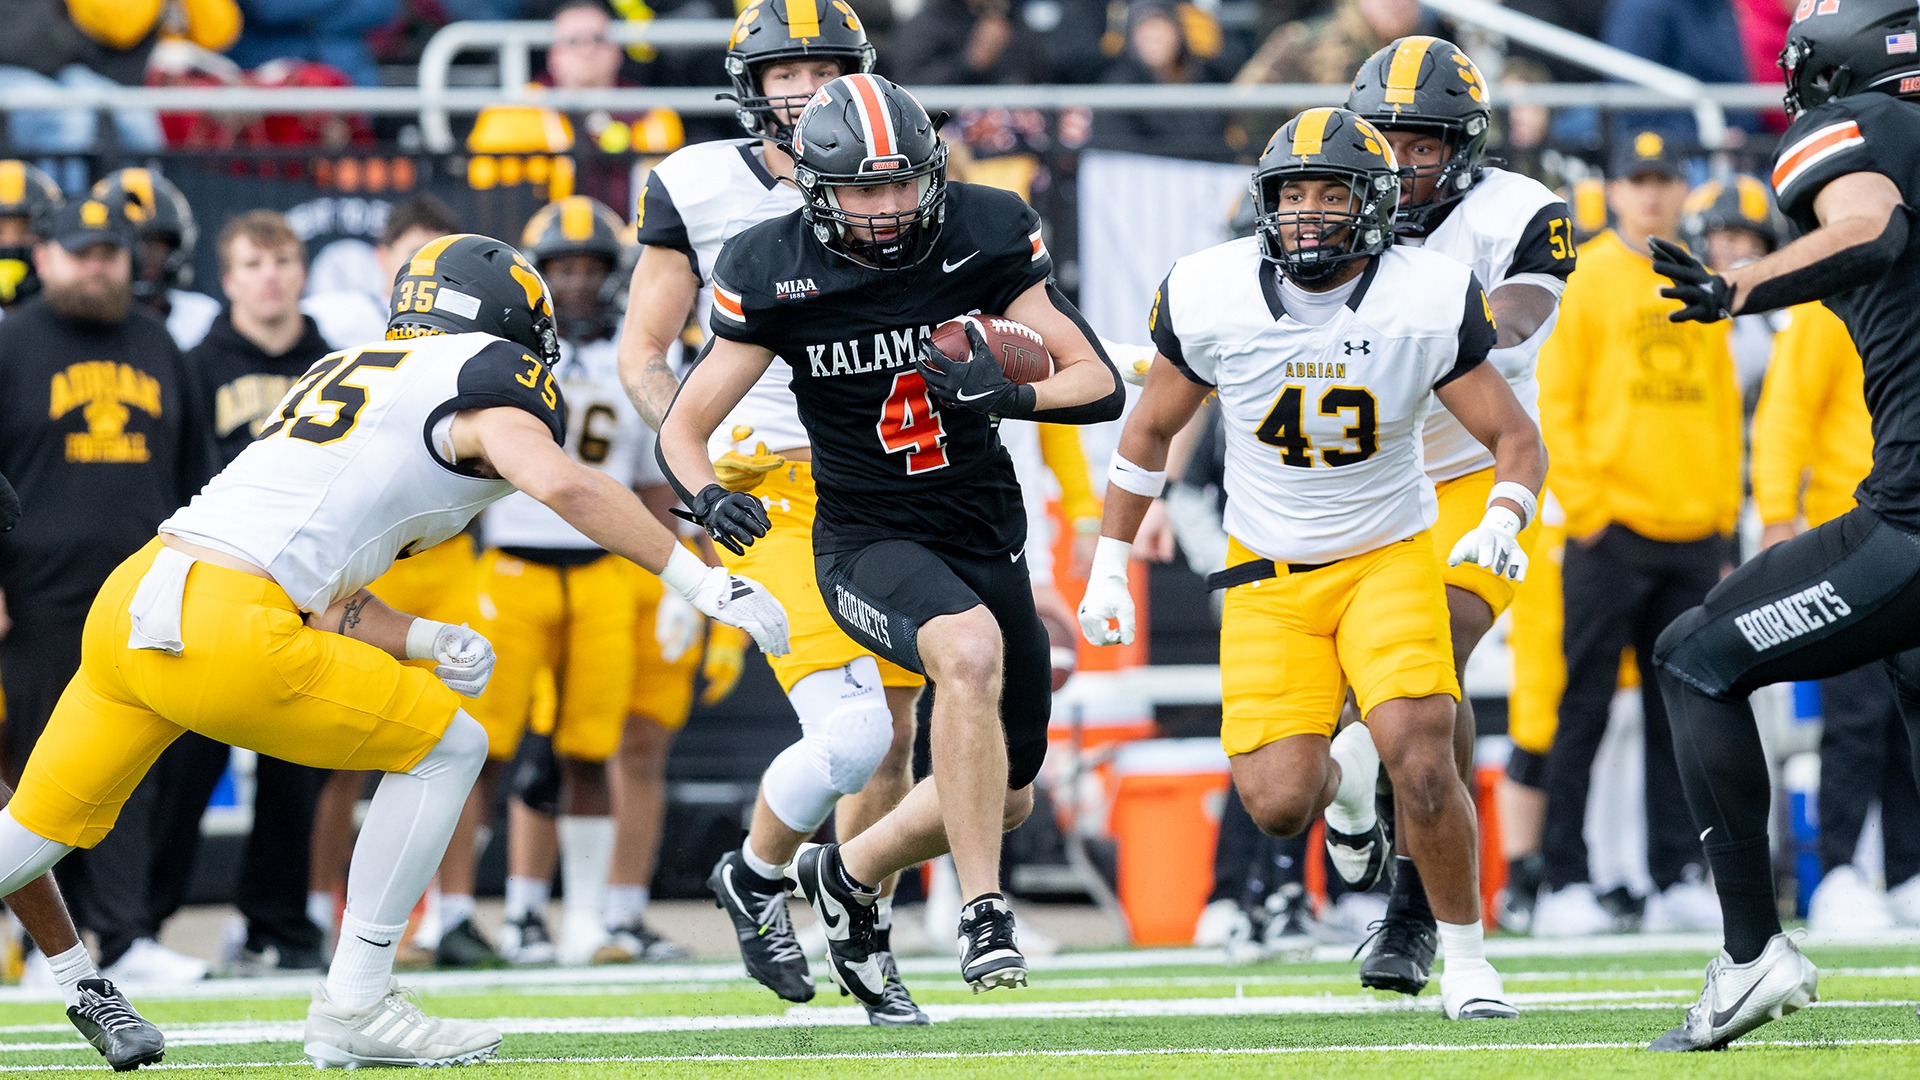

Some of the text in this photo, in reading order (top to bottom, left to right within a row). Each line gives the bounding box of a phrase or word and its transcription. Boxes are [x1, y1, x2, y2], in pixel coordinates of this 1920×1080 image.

[872, 160, 899, 171] SWARM
[1548, 217, 1576, 260] 51
[397, 280, 439, 313] 35
[775, 278, 818, 295] MIAA
[789, 292, 806, 300] 1888
[514, 353, 559, 411] 35
[1285, 362, 1346, 379] ADRIAN
[876, 368, 950, 476] 4
[1253, 384, 1380, 469] 43
[835, 583, 893, 649] HORNETS
[1733, 580, 1852, 652] HORNETS
[840, 685, 873, 699] MUELLER
